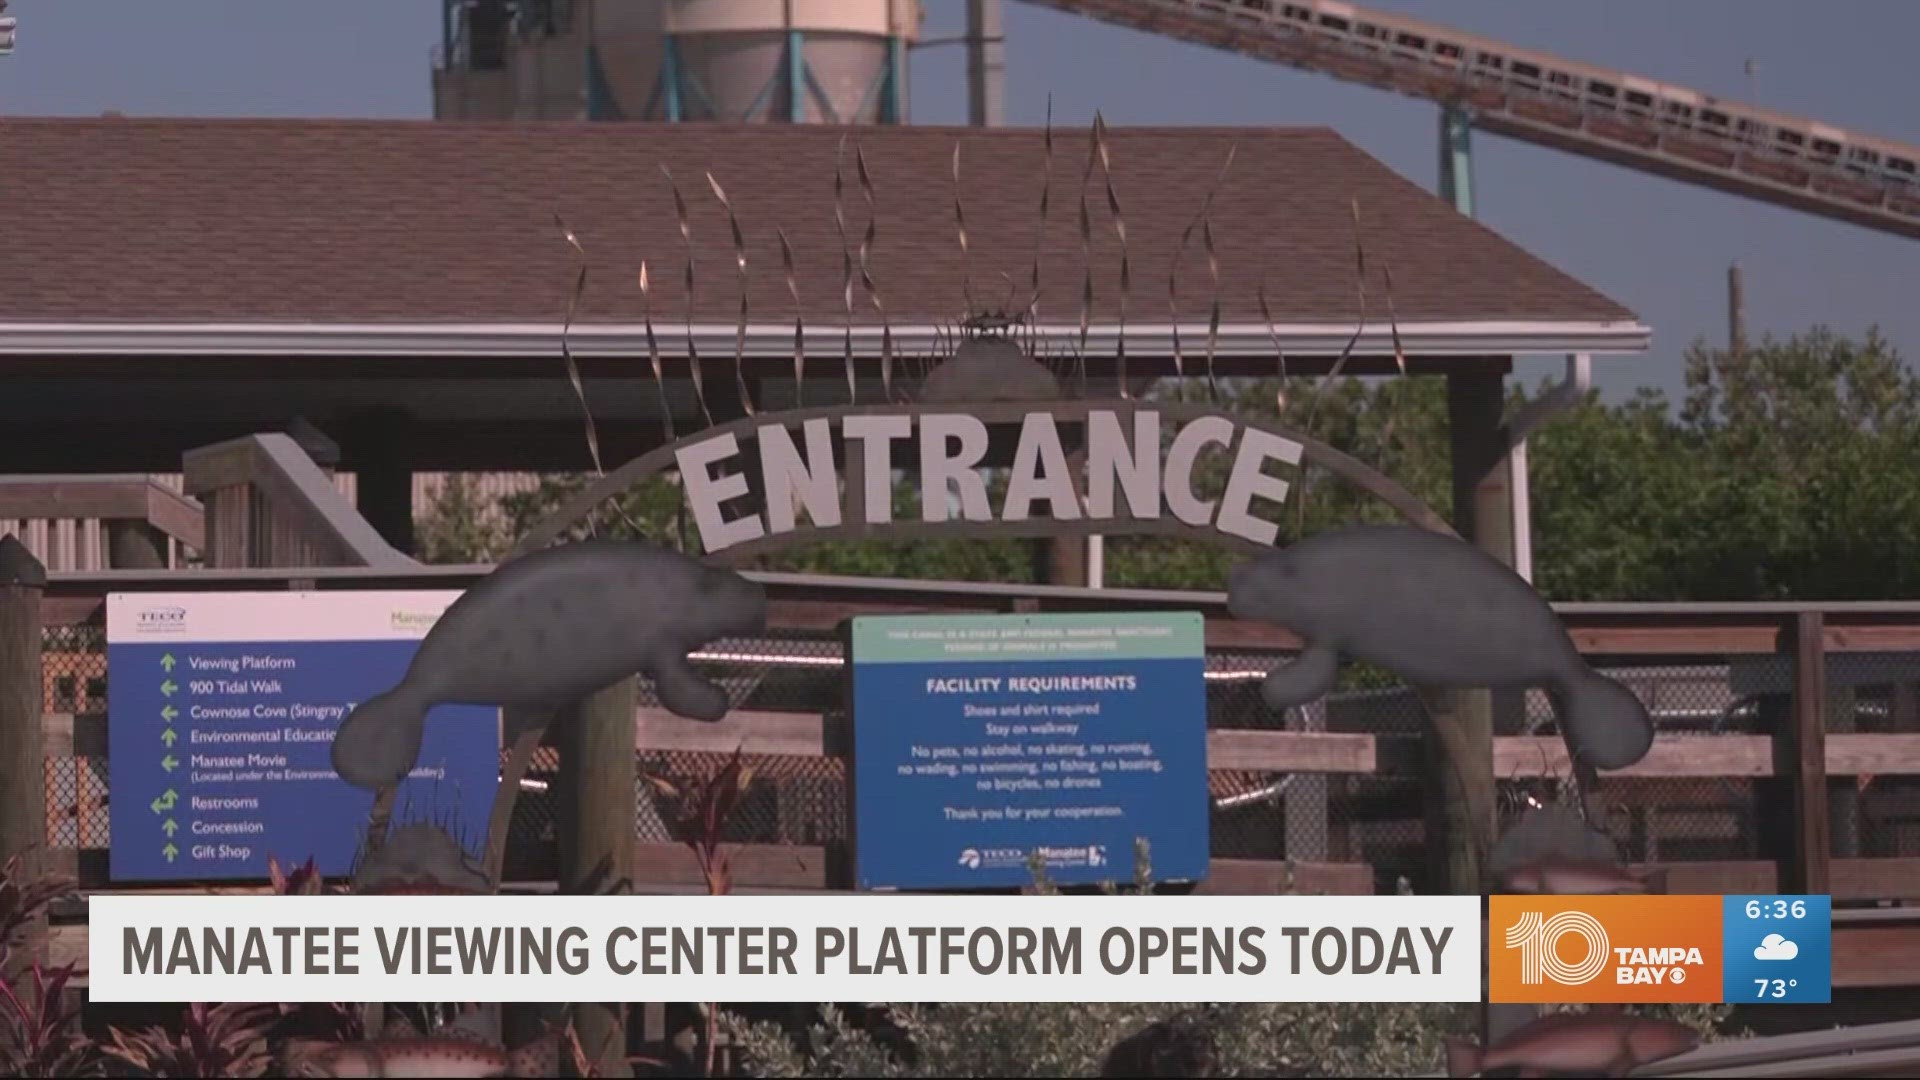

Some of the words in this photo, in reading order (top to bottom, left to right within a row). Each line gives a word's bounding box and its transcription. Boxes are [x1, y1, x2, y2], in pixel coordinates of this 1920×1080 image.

[674, 410, 1304, 553] ENTRANCE
[189, 656, 239, 672] Viewing
[242, 655, 296, 669] Platform
[189, 680, 214, 694] 900
[217, 680, 248, 694] Tidal
[251, 680, 282, 693] Walk
[927, 677, 1001, 693] FACILITY
[1008, 675, 1136, 694] REQUIREMENTS
[190, 705, 250, 719] Cownose
[253, 704, 287, 718] Cove
[290, 703, 344, 720] (Stingray
[964, 703, 997, 717] Shoes
[1000, 703, 1021, 716] and
[1023, 703, 1049, 716] shirt
[1051, 702, 1099, 717] required
[191, 729, 281, 743] Environmental
[284, 727, 337, 742] Educatio
[986, 722, 1010, 738] Stay
[1012, 724, 1028, 734] on
[1030, 721, 1079, 736] walkway
[911, 746, 930, 757] No
[932, 747, 961, 760] pets,
[963, 748, 979, 757] no
[981, 744, 1026, 758] alcohol,
[1028, 746, 1044, 756] no
[1045, 744, 1088, 758] skating,
[1090, 745, 1106, 755] no
[1107, 743, 1153, 757] running,
[191, 754, 244, 767] Manatee
[248, 753, 287, 766] Movie
[898, 765, 914, 775] no
[915, 762, 960, 777] wading,
[962, 763, 978, 774] no
[980, 762, 1039, 776] swimming,
[1042, 763, 1058, 773] no
[1060, 759, 1099, 774] fishing,
[1101, 761, 1118, 771] no
[1118, 758, 1163, 773] boating,
[191, 770, 233, 783] (Located
[236, 770, 264, 781] under
[267, 769, 283, 780] the
[285, 768, 339, 780] Environme
[976, 780, 992, 791] no
[994, 777, 1043, 792] bicycles,
[1044, 778, 1061, 788] no
[1062, 776, 1101, 788] drones
[191, 795, 259, 810] Restrooms
[944, 806, 979, 820] Thank
[981, 809, 1003, 822] you
[1005, 806, 1023, 819] for
[1025, 808, 1051, 821] your
[1053, 805, 1123, 819] cooperation.
[191, 820, 264, 834] Concession
[192, 845, 216, 859] Gift
[218, 845, 251, 861] Shop
